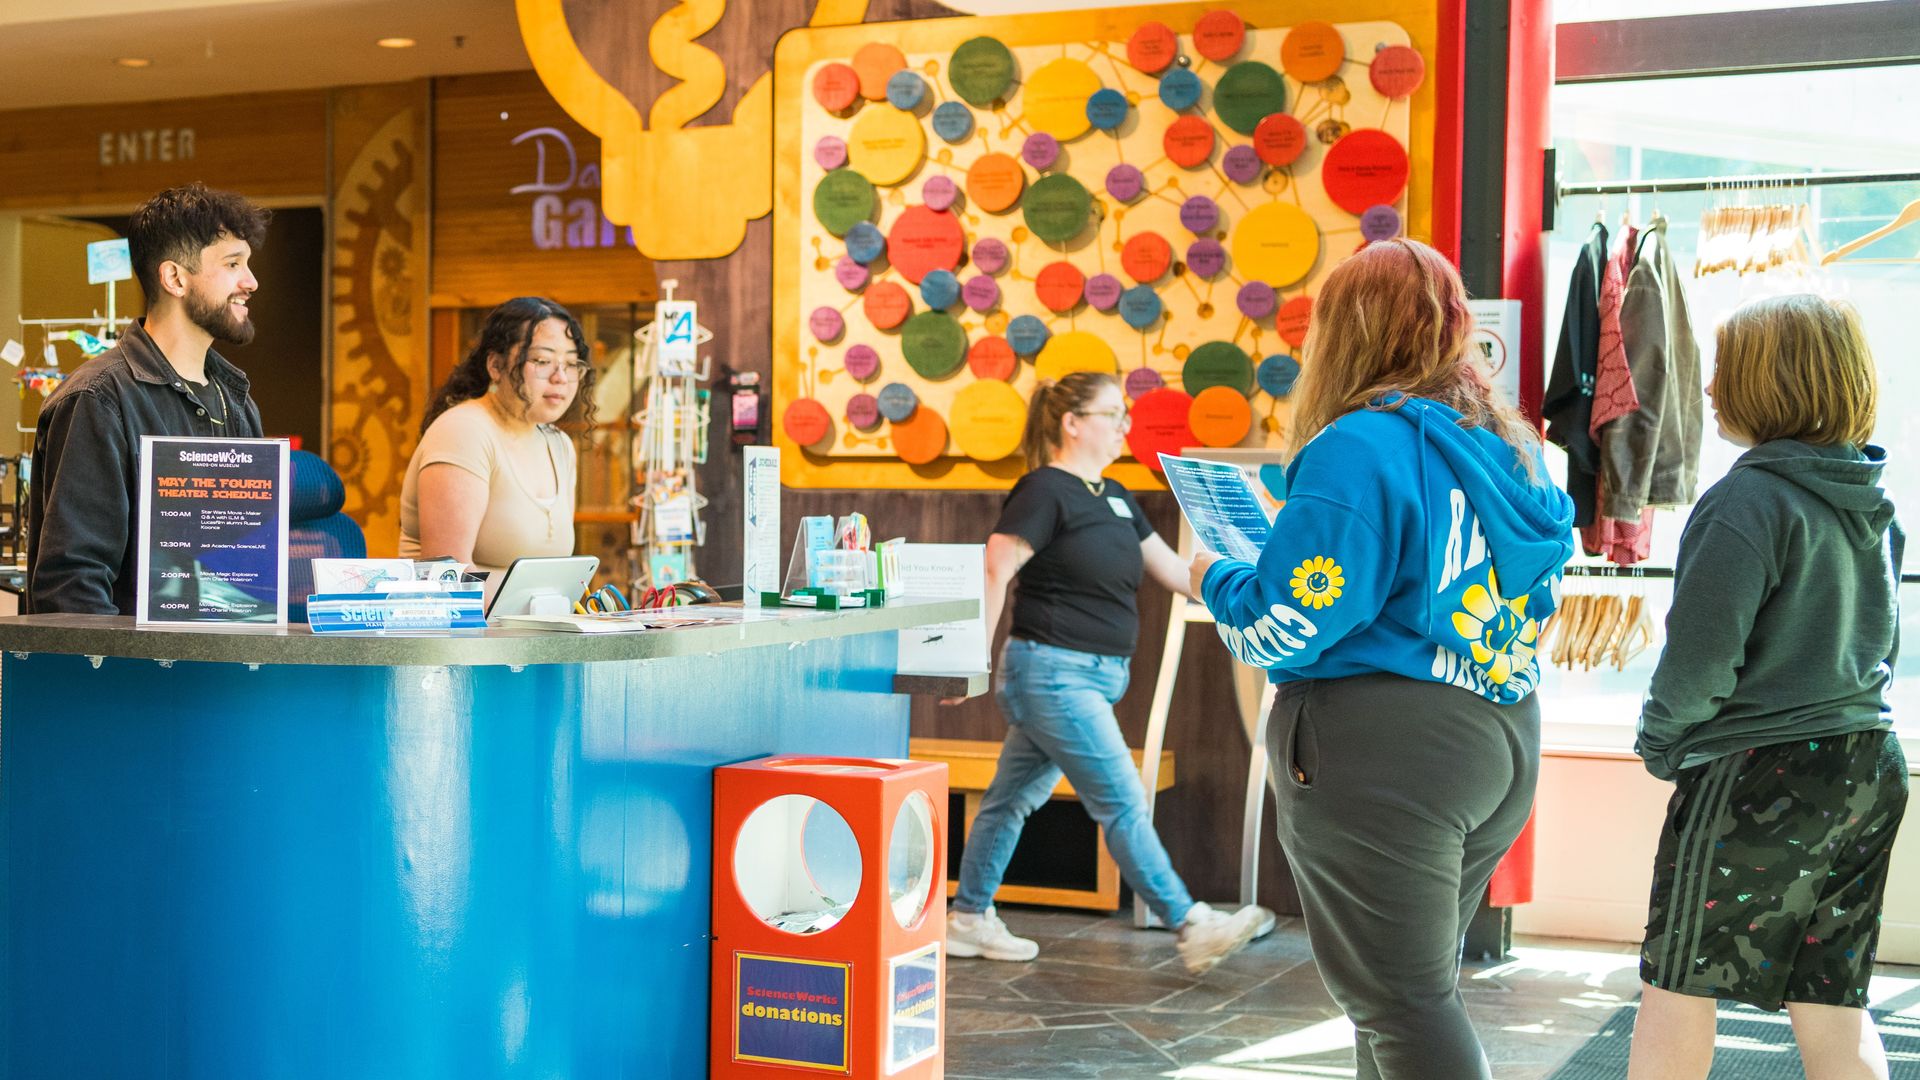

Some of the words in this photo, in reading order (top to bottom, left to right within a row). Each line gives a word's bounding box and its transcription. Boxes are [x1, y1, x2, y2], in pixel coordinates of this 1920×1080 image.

[100, 128, 195, 166] ENTER
[180, 449, 253, 463] ScienceWorks
[158, 477, 188, 487] MAY
[191, 477, 216, 488] THE
[220, 478, 272, 489] FOURTH
[158, 489, 208, 498] THEATER
[212, 490, 272, 500] SCHEDULE:
[746, 986, 838, 1005] ScienceWorks
[741, 1002, 843, 1026] donations
